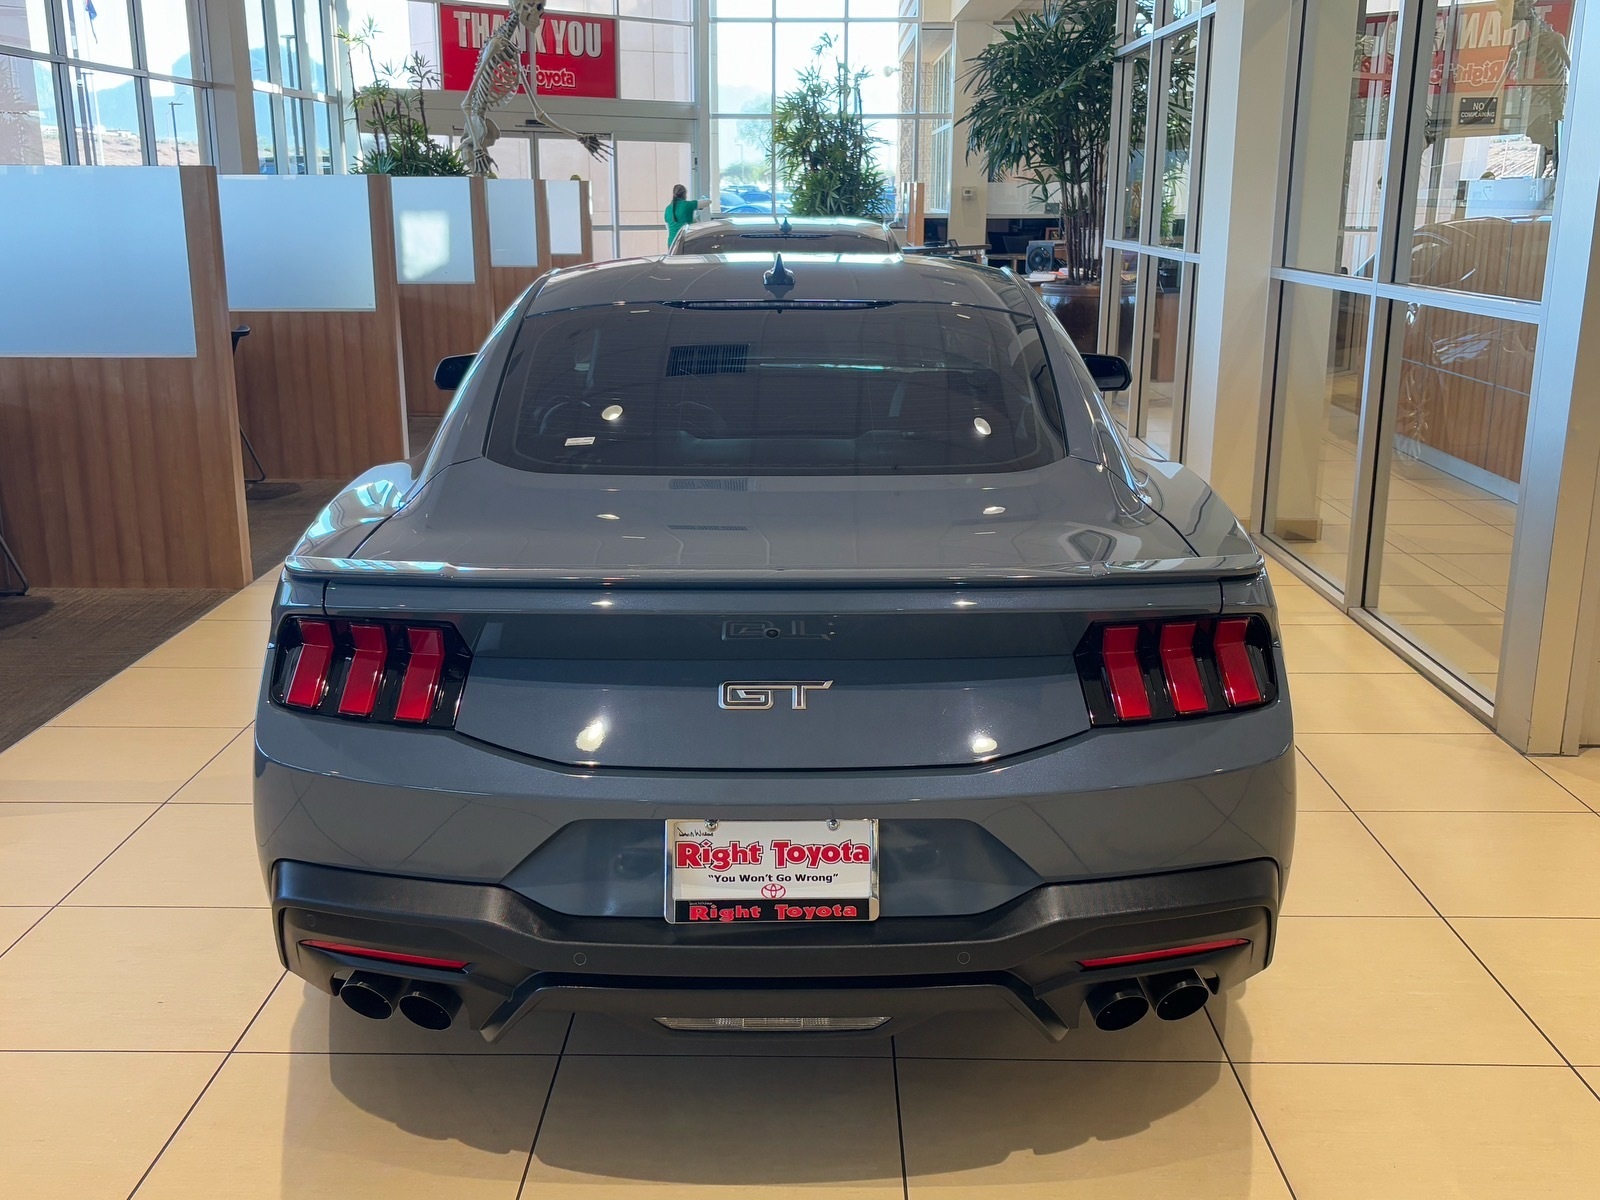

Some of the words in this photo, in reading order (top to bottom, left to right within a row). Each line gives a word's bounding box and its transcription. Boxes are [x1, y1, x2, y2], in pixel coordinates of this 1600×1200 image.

[550, 19, 602, 58] YOU
[527, 64, 576, 89] oyota
[1472, 102, 1485, 111] NO
[718, 680, 834, 710] GT
[675, 839, 763, 872] Right
[770, 839, 871, 869] Toyota
[739, 873, 773, 883] Won't
[777, 873, 792, 883] Go
[689, 904, 762, 922] Right
[774, 903, 858, 920] Toyota
